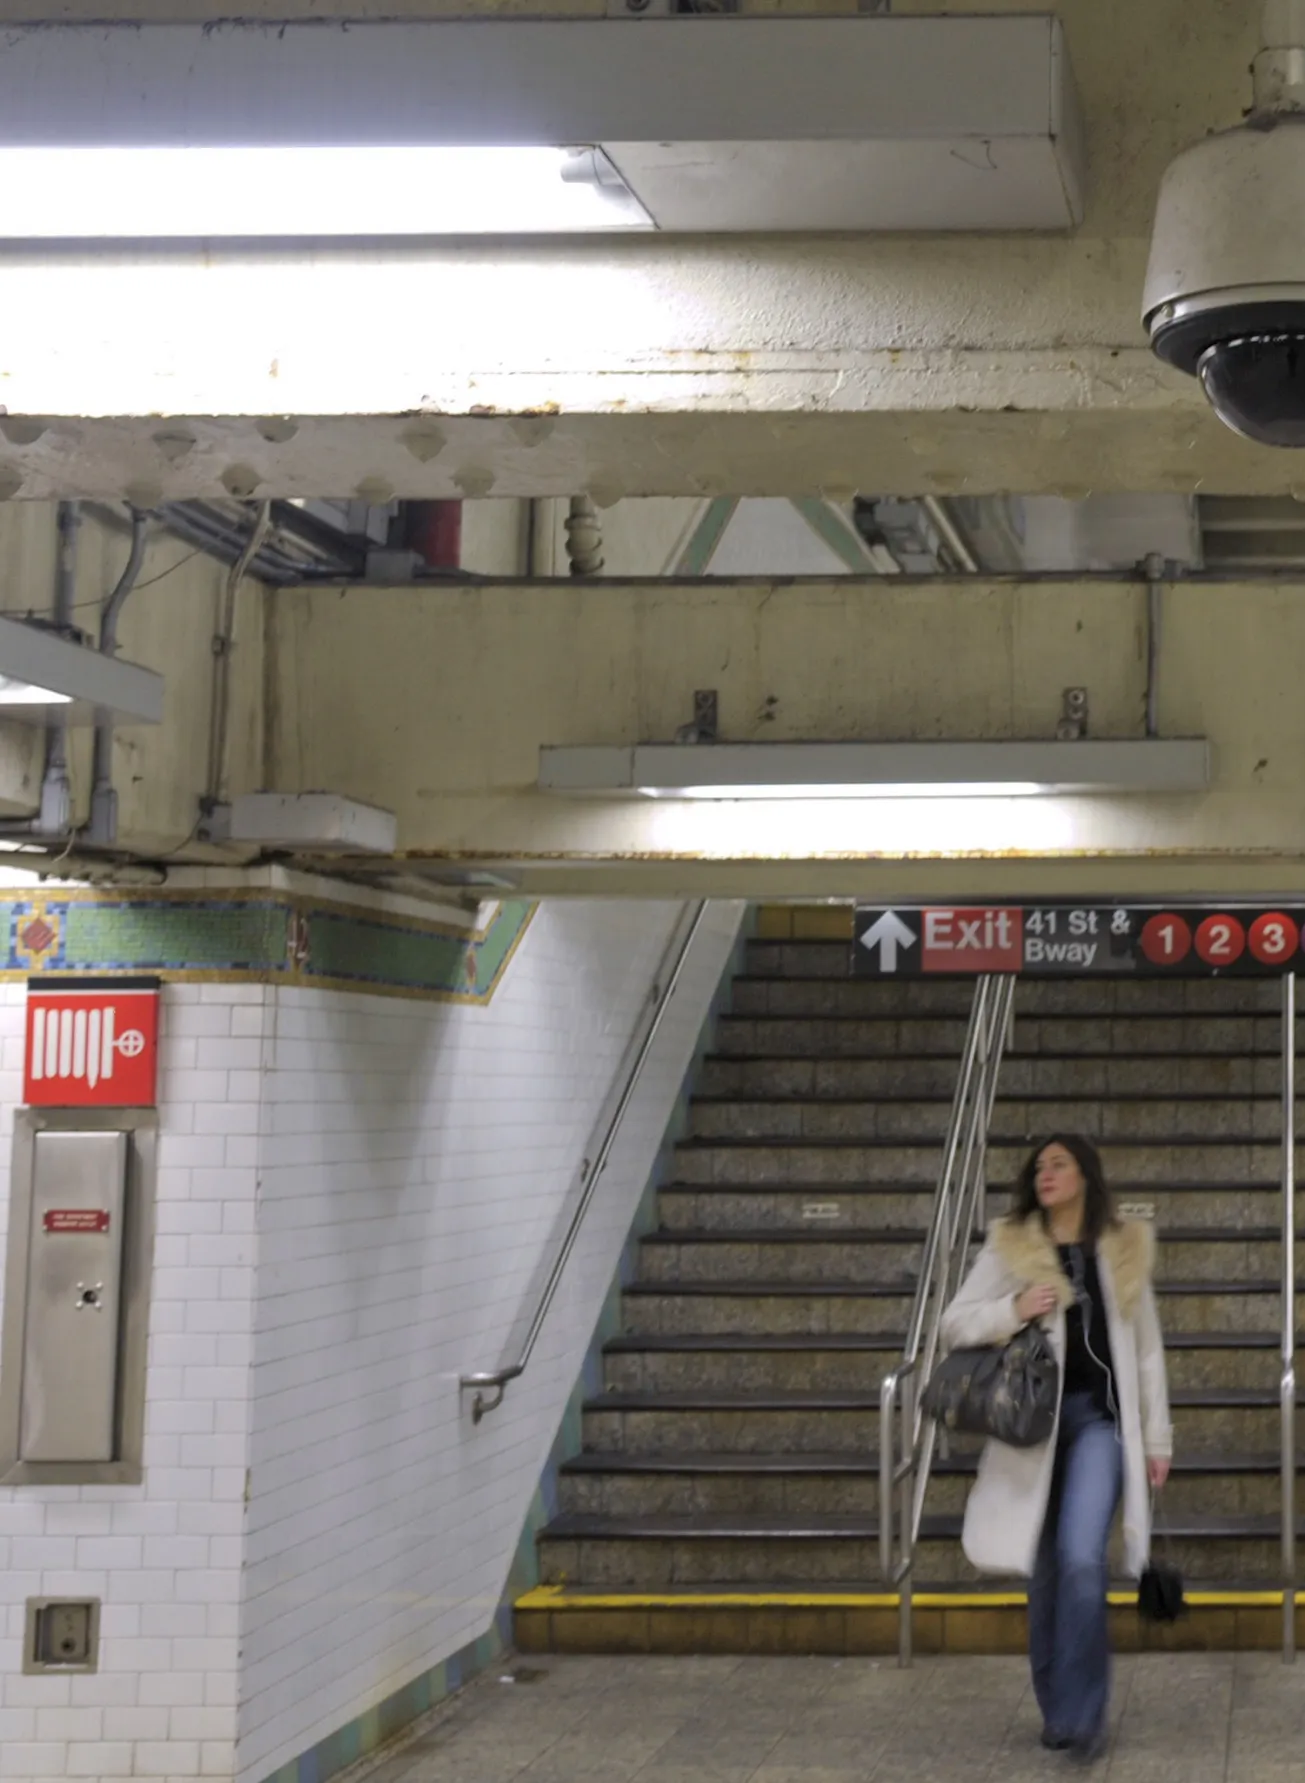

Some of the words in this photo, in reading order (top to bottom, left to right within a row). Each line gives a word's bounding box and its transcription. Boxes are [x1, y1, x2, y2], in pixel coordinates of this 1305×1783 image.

[925, 911, 1012, 949] Exit
[1024, 910, 1056, 935] 41
[1068, 910, 1098, 935] St
[1110, 909, 1131, 935] &
[1024, 938, 1098, 967] Bway
[1158, 924, 1173, 954] 1
[1209, 924, 1230, 954] 2
[1262, 922, 1285, 954] 3
